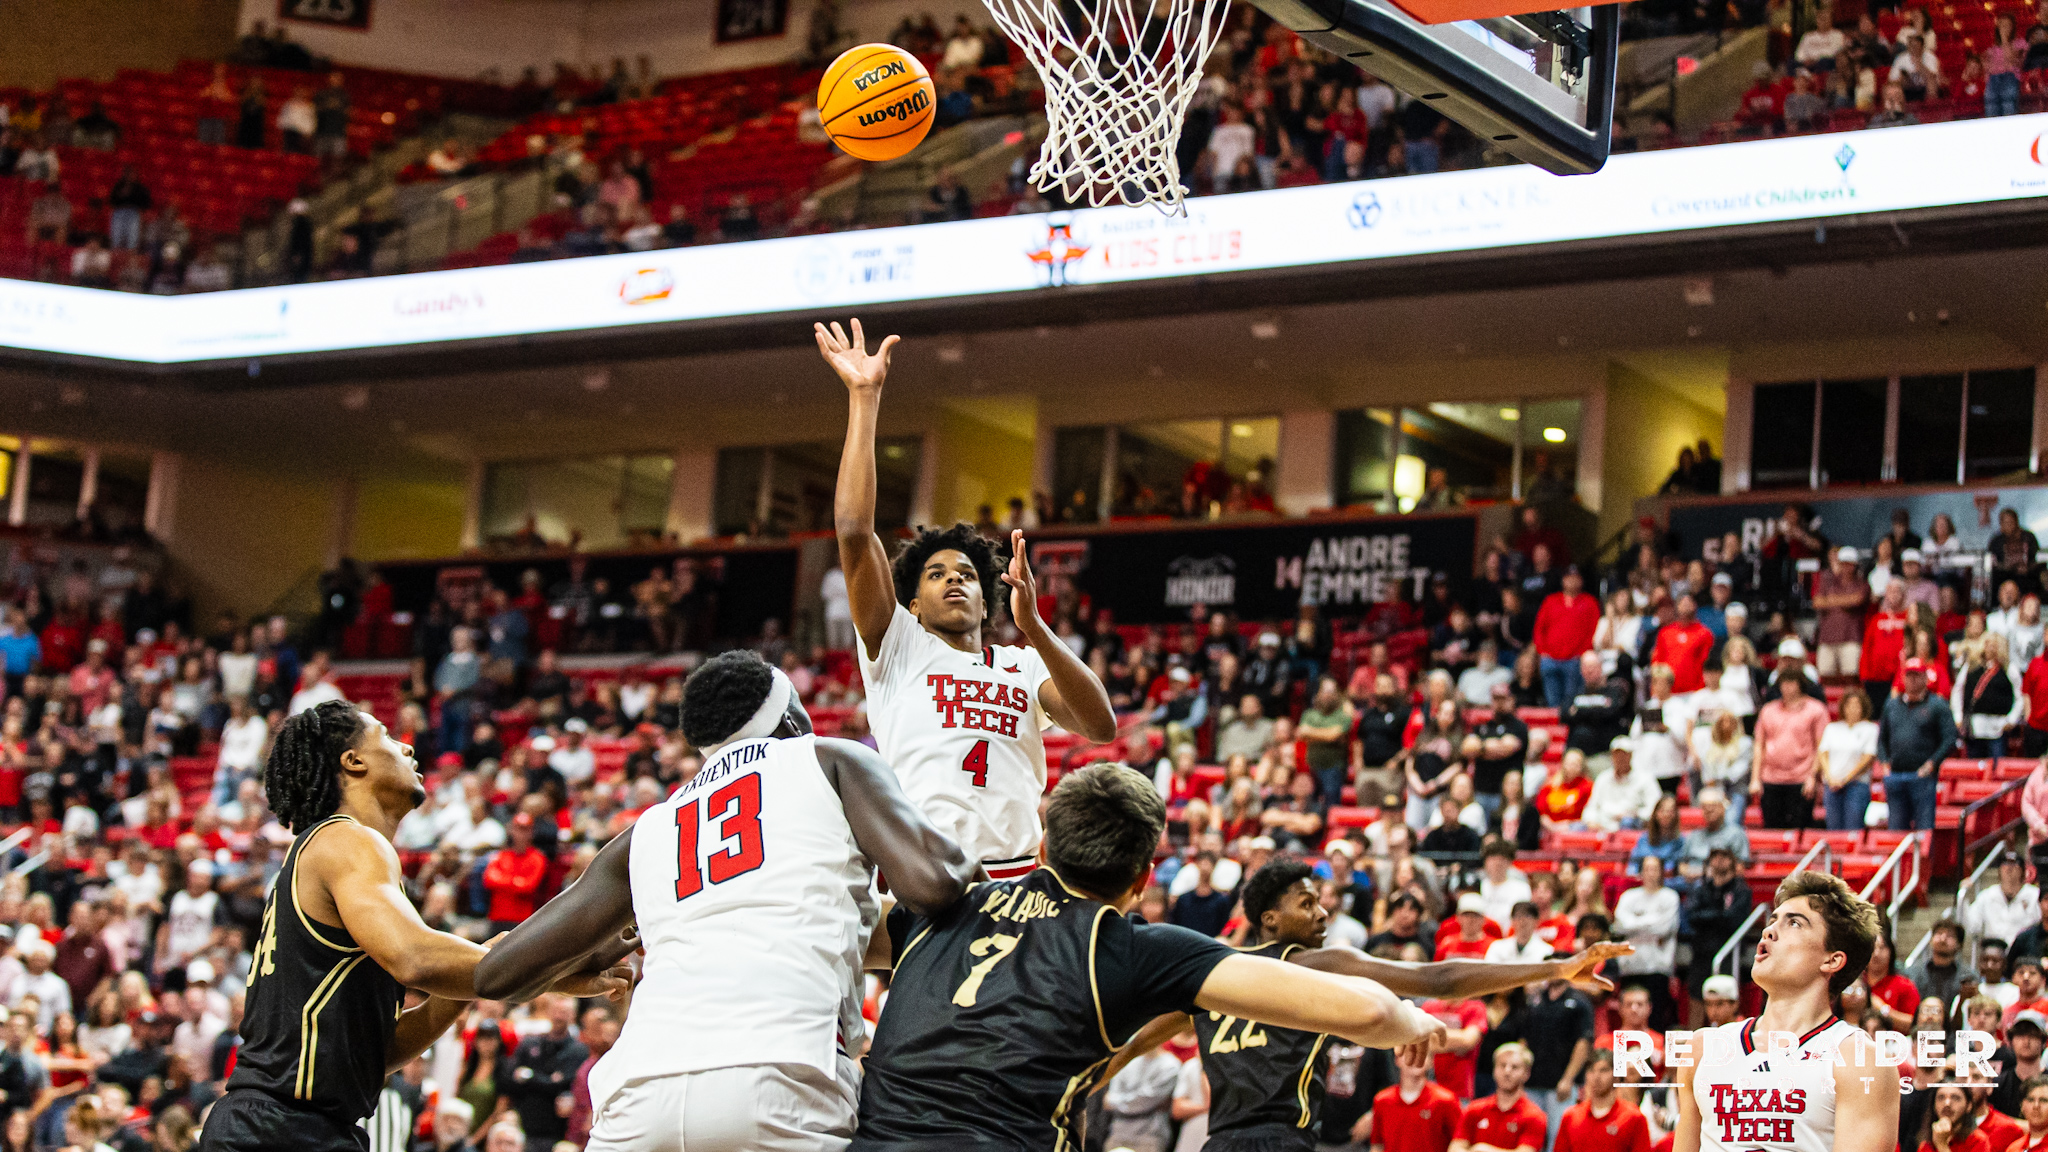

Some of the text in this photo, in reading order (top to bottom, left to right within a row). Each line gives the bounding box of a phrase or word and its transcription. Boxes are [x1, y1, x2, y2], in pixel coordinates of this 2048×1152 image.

[853, 60, 906, 92] NCAA
[858, 88, 931, 127] Wilson
[1174, 229, 1242, 265] CLUB
[1305, 534, 1412, 570] ANDRE
[927, 674, 1029, 714] TEXAS
[936, 701, 1019, 739] TECH
[961, 739, 989, 788] 4
[674, 771, 765, 902] 13
[951, 932, 1024, 1008] 7
[1208, 1010, 1268, 1055] 22
[1709, 1083, 1807, 1114] TEXAS
[1717, 1112, 1795, 1143] TECH
